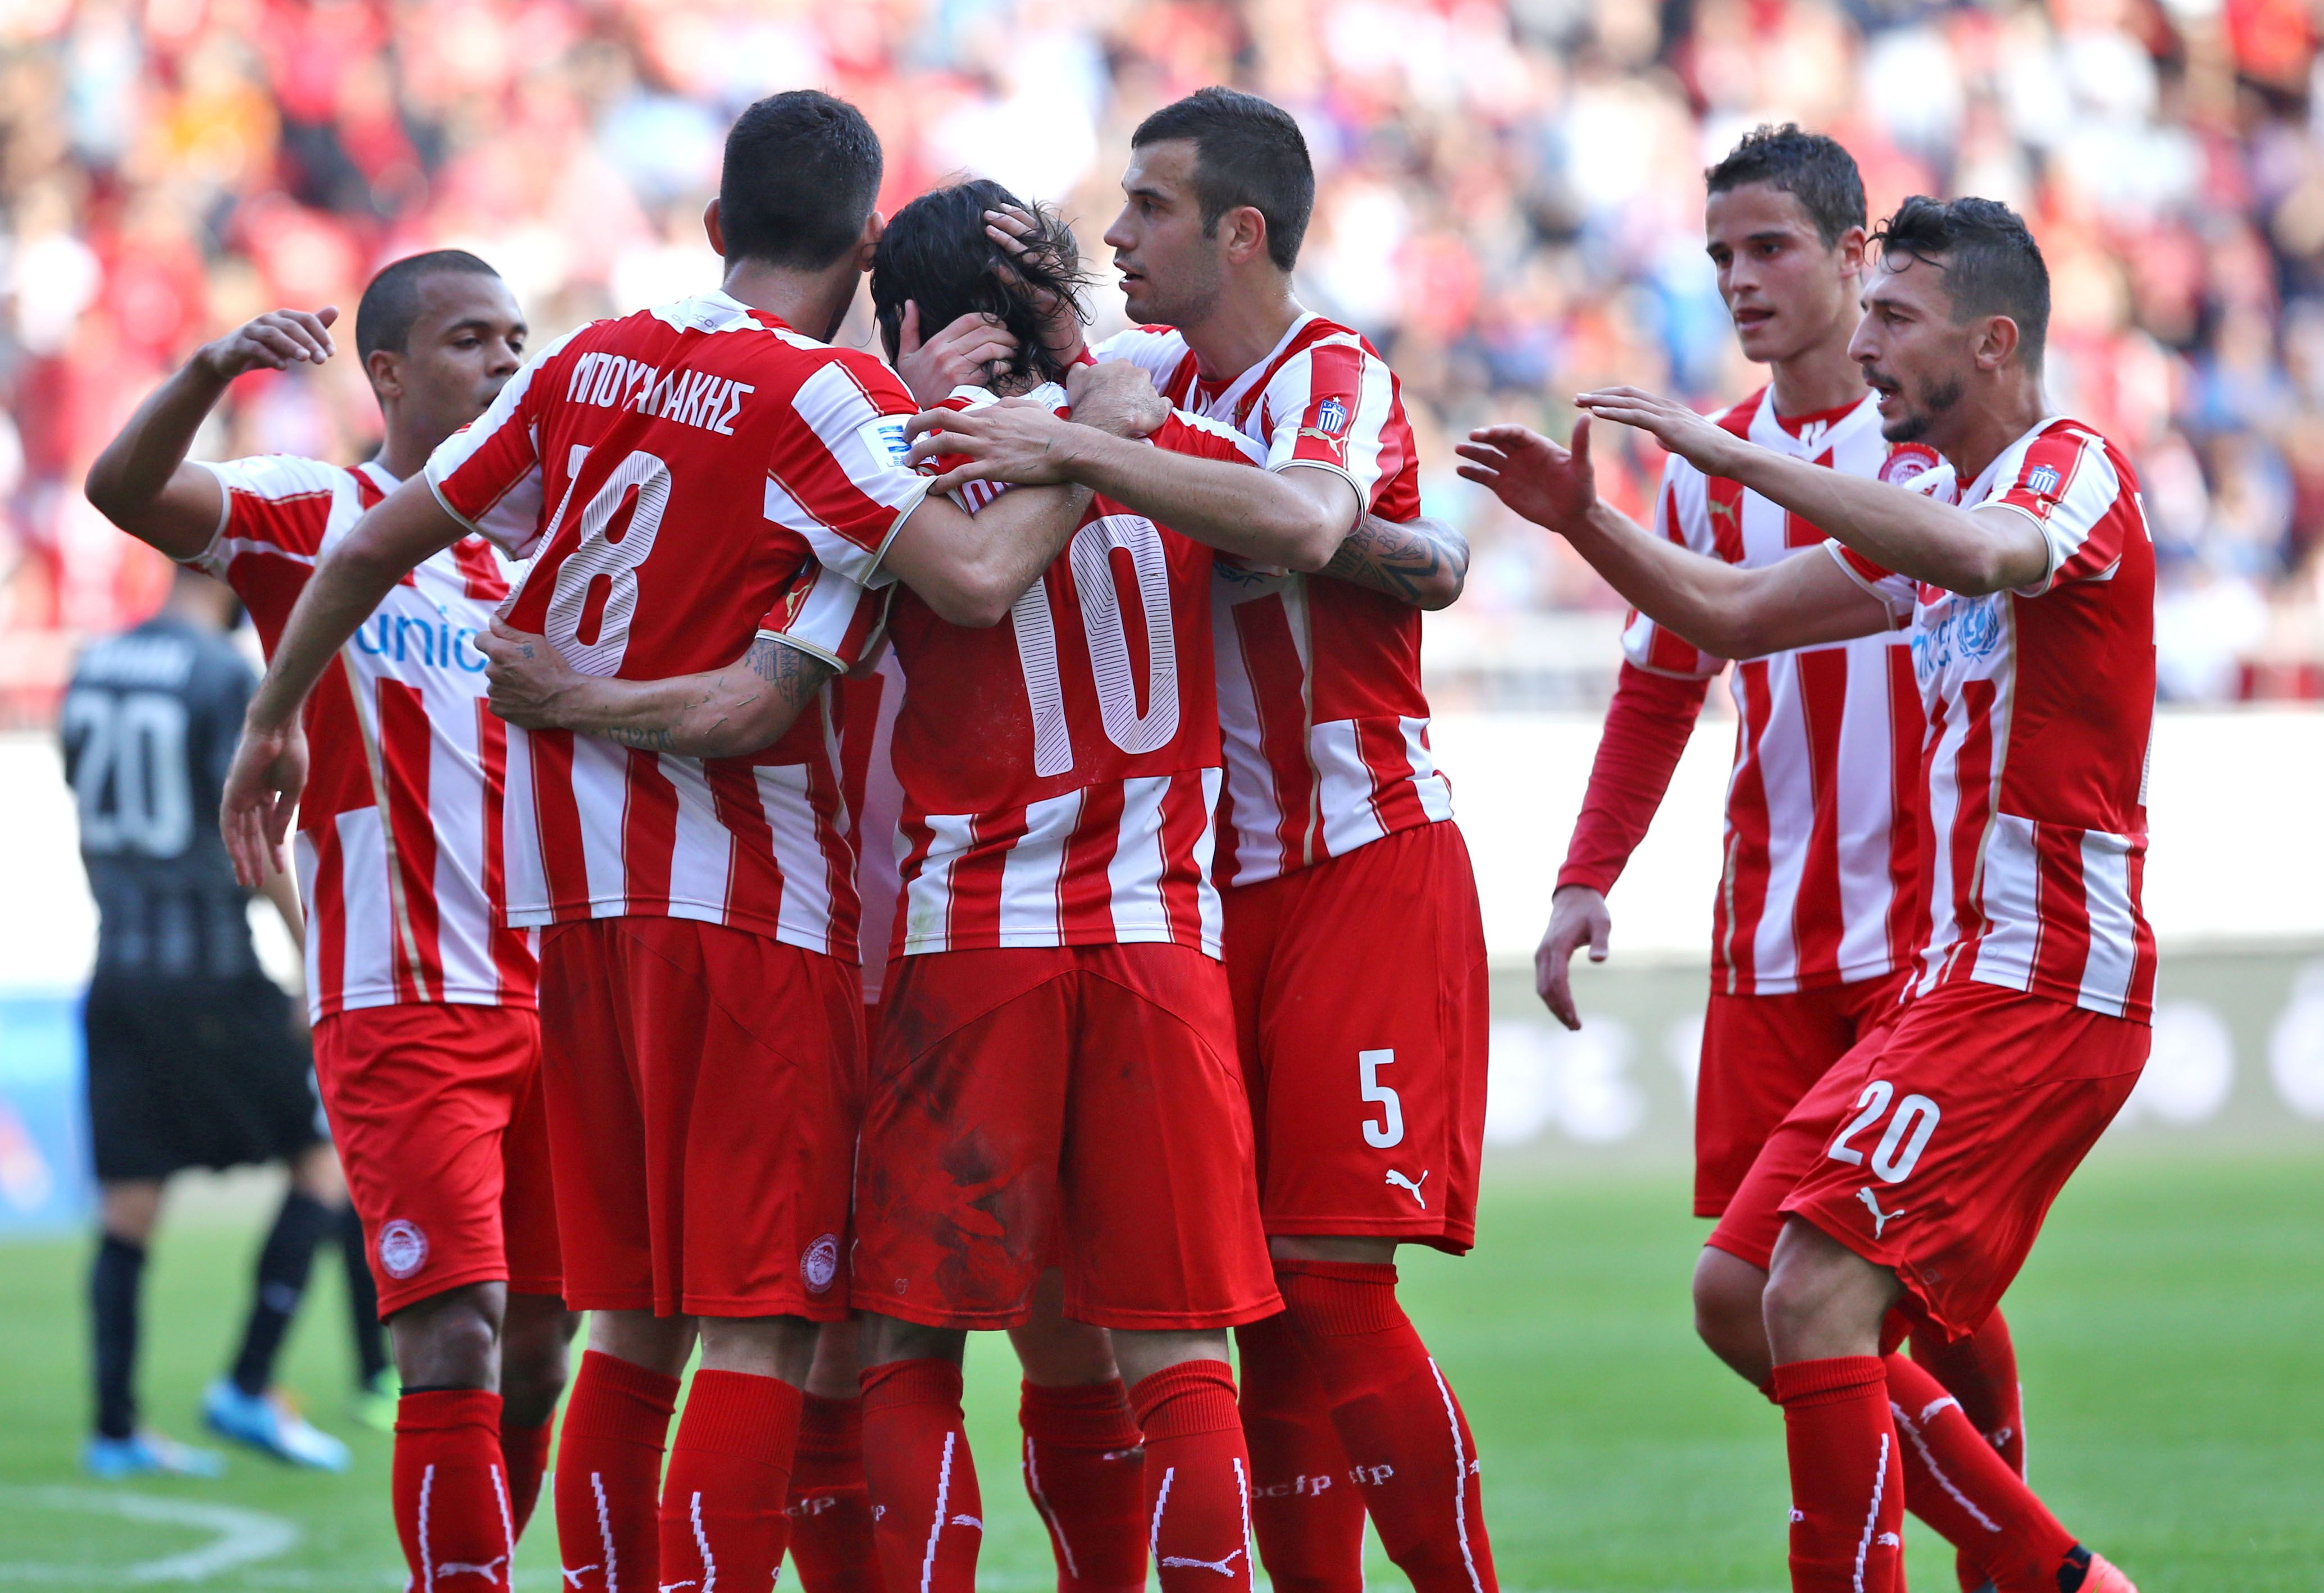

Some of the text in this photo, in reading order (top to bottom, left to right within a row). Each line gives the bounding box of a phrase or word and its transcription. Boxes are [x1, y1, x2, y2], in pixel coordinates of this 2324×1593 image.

[495, 445, 672, 677] 18
[354, 605, 489, 672] unic
[1011, 514, 1180, 778] 10
[62, 687, 195, 859] 20
[1359, 1048, 1404, 1148] 5
[1827, 1080, 1941, 1184] 20
